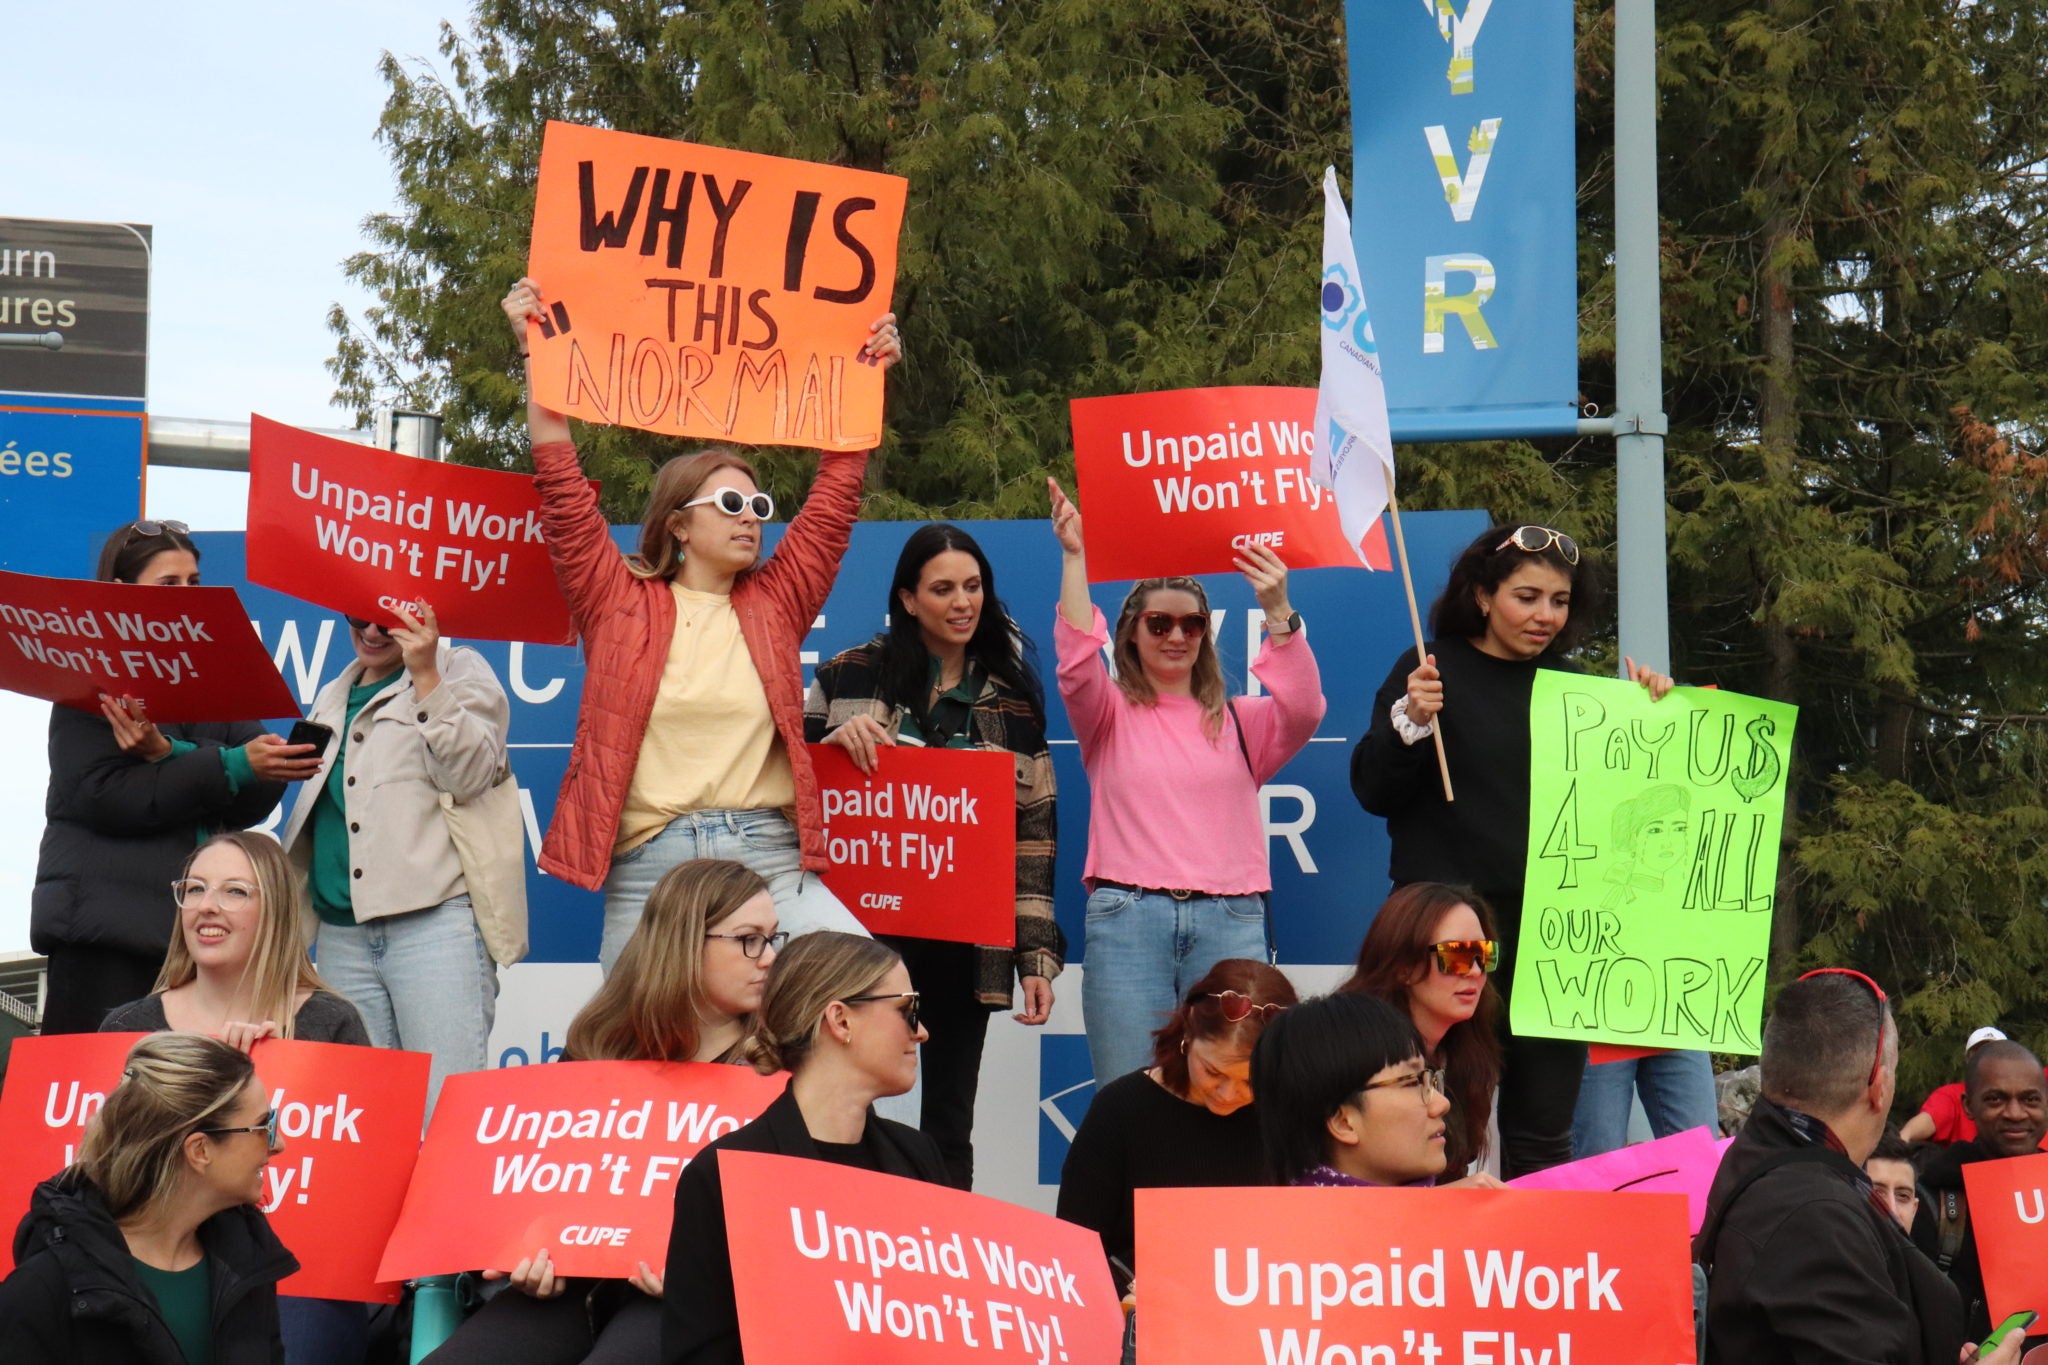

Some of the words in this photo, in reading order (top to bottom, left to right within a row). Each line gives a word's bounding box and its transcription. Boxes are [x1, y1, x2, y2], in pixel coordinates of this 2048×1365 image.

[578, 160, 752, 278] WHY
[784, 190, 876, 304] IS
[645, 279, 778, 354] THIS
[1339, 341, 1375, 371] CANADIAN
[1122, 422, 1263, 471] Unpaid
[1268, 421, 1315, 456] Wo
[291, 462, 433, 531] Unpaid
[446, 499, 546, 544] Work
[1153, 471, 1266, 513] Won't
[315, 515, 423, 577] Won't
[434, 546, 509, 591] Fly!
[0, 603, 104, 639] npaid
[104, 611, 214, 642] Work
[8, 632, 119, 678] Won't
[120, 651, 200, 685] Fly!
[1563, 692, 1676, 779] PAY
[822, 780, 894, 823] paid
[902, 784, 979, 824] Work
[823, 828, 892, 867] on't
[901, 833, 954, 879] Fly!
[1539, 777, 1598, 889] 4
[1682, 809, 1772, 912] ALL
[860, 892, 902, 911] CUPE
[1540, 907, 1626, 955] OUR
[1536, 957, 1765, 1052] WORK
[270, 1088, 364, 1143] ork
[475, 1099, 653, 1148] Unpaid
[666, 1102, 760, 1143] Wo
[491, 1153, 631, 1195] Won't
[559, 1225, 631, 1247] CUPE
[789, 1207, 969, 1278] Unpaid
[973, 1236, 1086, 1307] Work
[1214, 1247, 1446, 1321] Unpaid
[1463, 1249, 1623, 1311] Work
[834, 1279, 979, 1348] Won't
[986, 1301, 1069, 1365] Fly!
